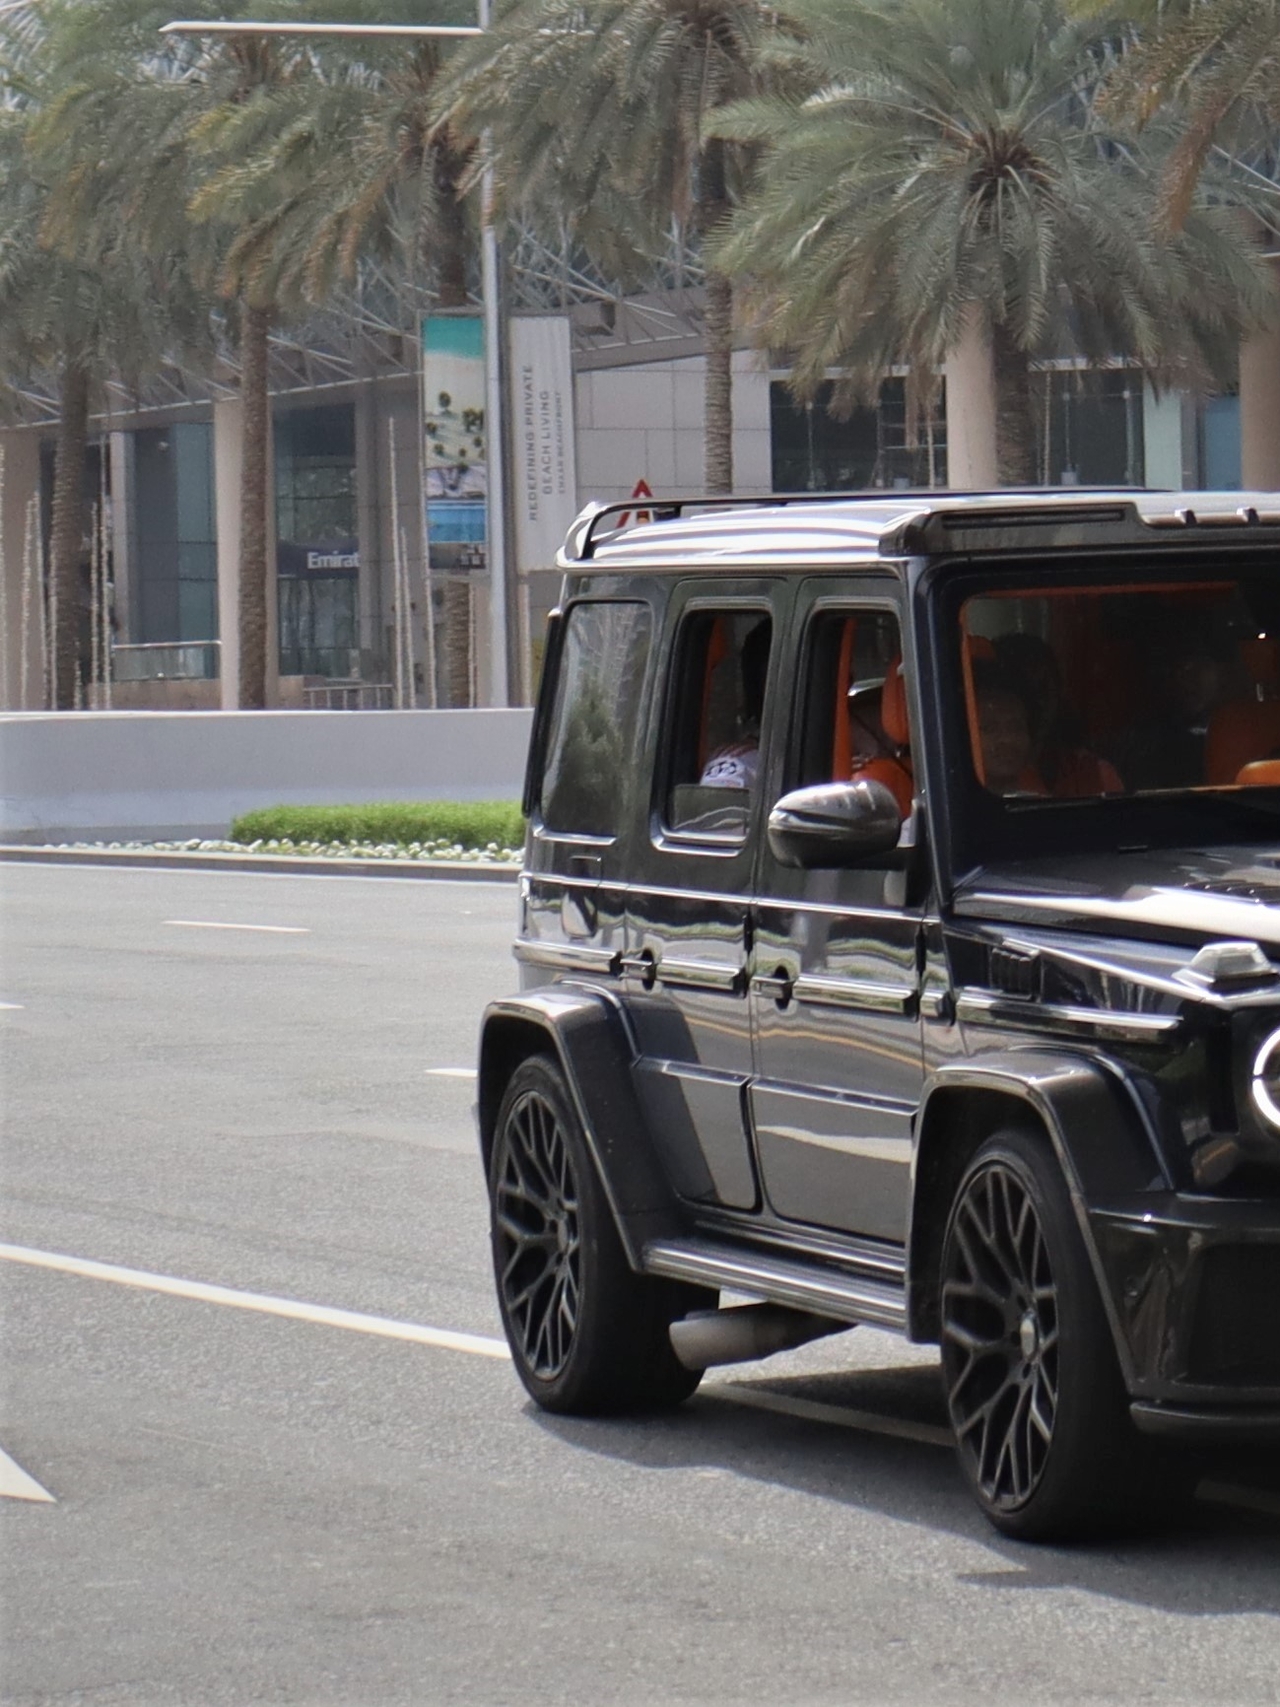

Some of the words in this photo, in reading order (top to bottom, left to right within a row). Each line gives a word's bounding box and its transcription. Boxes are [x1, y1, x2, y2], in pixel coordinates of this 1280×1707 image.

[523, 365, 534, 425] PRIVATE
[540, 391, 551, 439] LIVING
[526, 432, 538, 521] REDEFINING
[541, 445, 553, 495] BEACH
